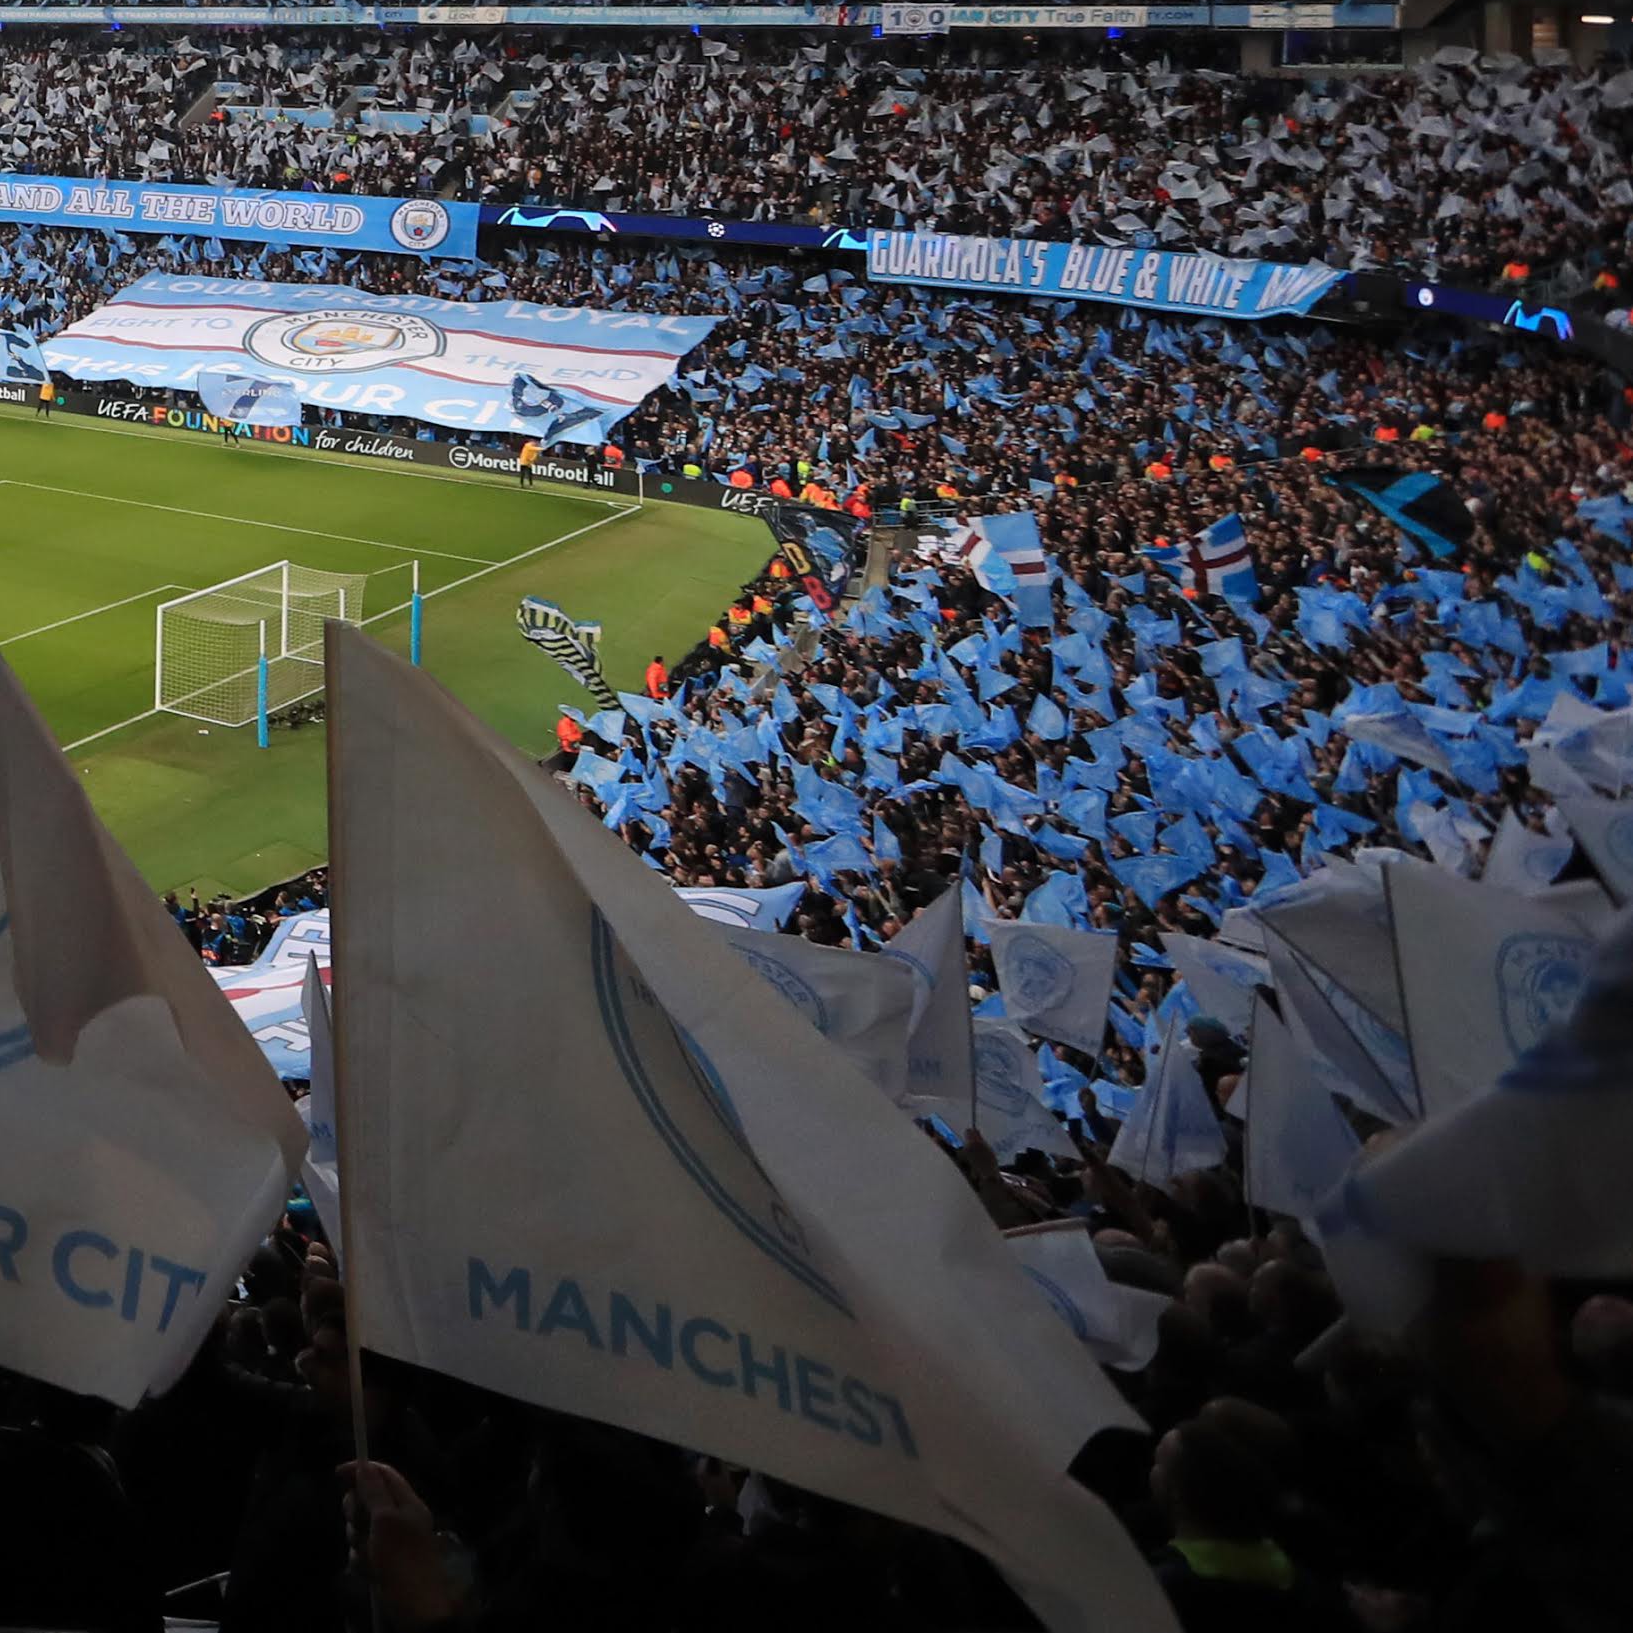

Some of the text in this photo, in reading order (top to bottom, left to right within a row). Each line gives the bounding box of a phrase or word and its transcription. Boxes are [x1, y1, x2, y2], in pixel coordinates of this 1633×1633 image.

[989, 9, 1039, 22] CITY
[1046, 9, 1136, 23] True Faith
[65, 187, 132, 218] ALL
[140, 192, 215, 225] THE
[219, 198, 364, 236] WORLD
[871, 230, 1251, 309] GUARDIOLA'S BLUE & WHITE
[285, 311, 429, 340] MANCHESTER
[504, 306, 689, 335] LOYAL
[87, 317, 641, 381] FIGHT TO THE END
[289, 356, 345, 368] CITY
[97, 397, 149, 422] UEFA
[315, 430, 338, 450] for
[345, 434, 415, 460] children
[468, 453, 615, 487] Moretnfootall
[720, 488, 771, 514] UEF
[51, 1227, 209, 1335] CIT
[465, 1254, 919, 1459] MANCHEST
